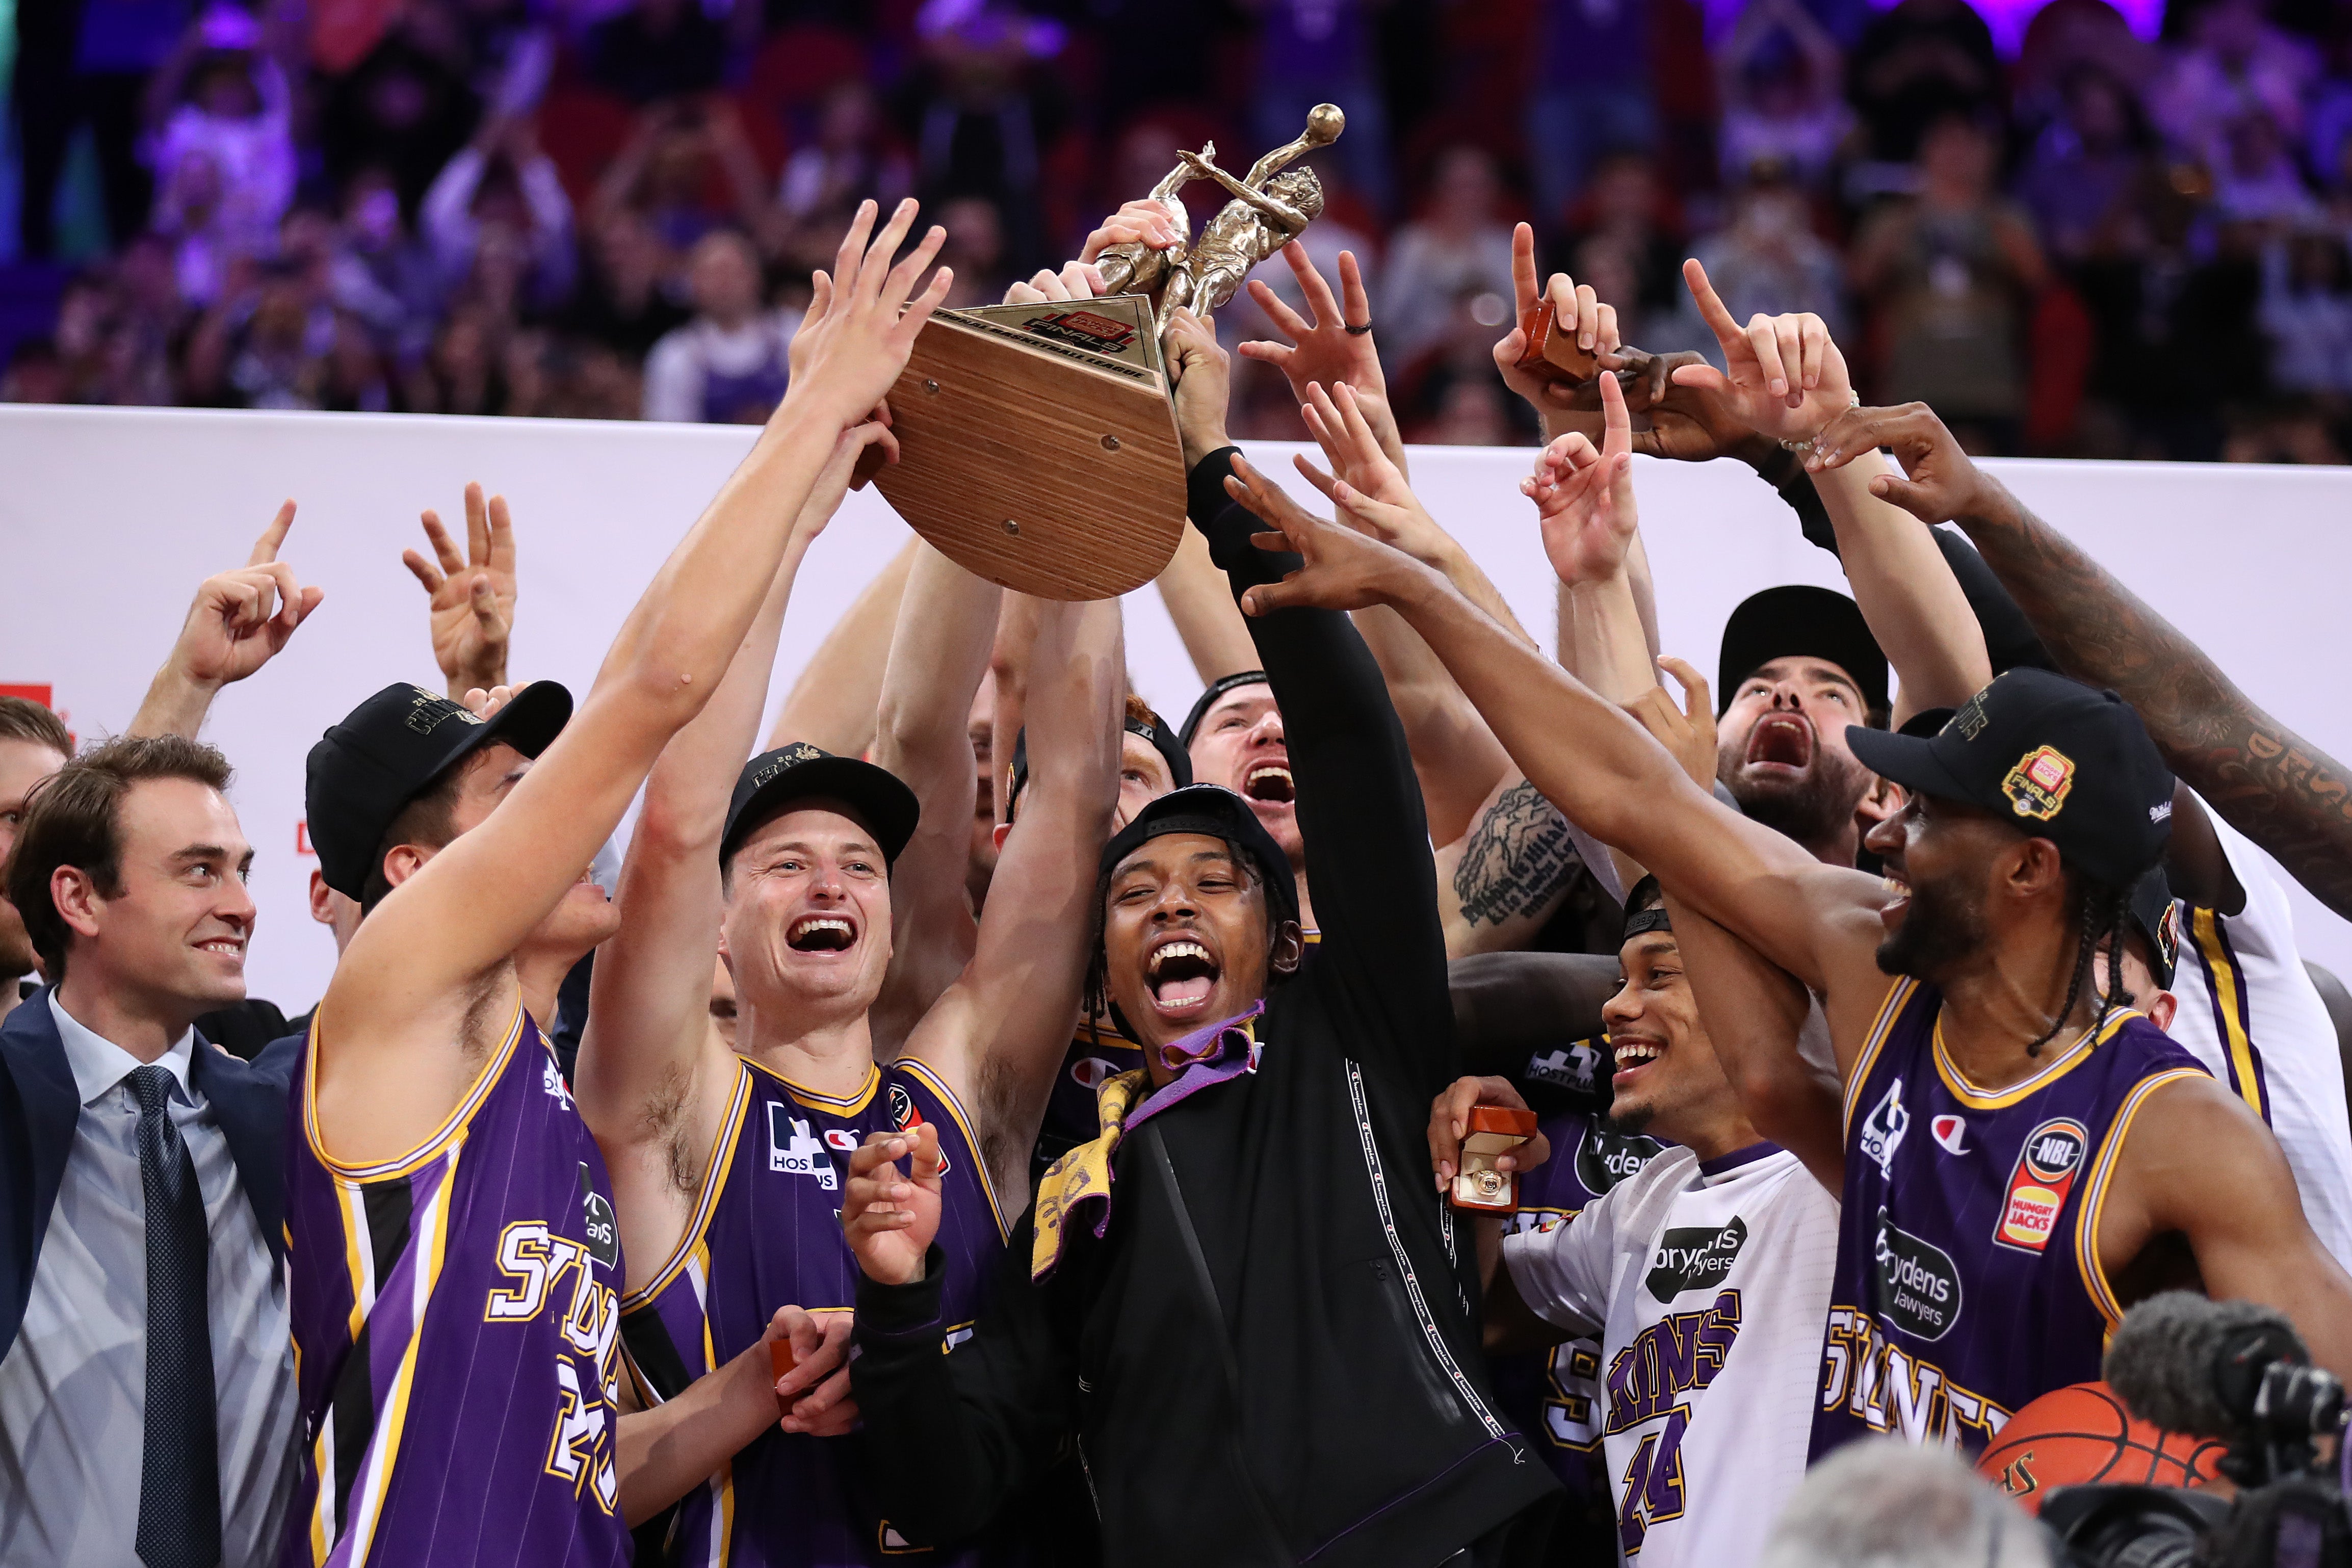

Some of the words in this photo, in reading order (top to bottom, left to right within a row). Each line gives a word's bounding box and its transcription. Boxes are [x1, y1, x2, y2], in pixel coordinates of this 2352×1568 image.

[989, 328, 1085, 360] BASKETBALL
[1086, 358, 1145, 378] LEAGUE
[1030, 320, 1121, 351] FINALS
[2011, 775, 2056, 808] FINALS
[1351, 1072, 1364, 1115] Champion
[1362, 1122, 1375, 1165] Champion
[2036, 1137, 2074, 1166] NBL
[1374, 1173, 1387, 1217] Champion
[2013, 1199, 2054, 1216] HUNGRY
[1387, 1224, 1406, 1266] Champion
[1876, 1227, 1949, 1302] brydens
[1407, 1273, 1426, 1318] Champion
[1894, 1286, 1943, 1325] lawyers
[1427, 1324, 1450, 1366] Champion
[1454, 1371, 1481, 1410] Champion
